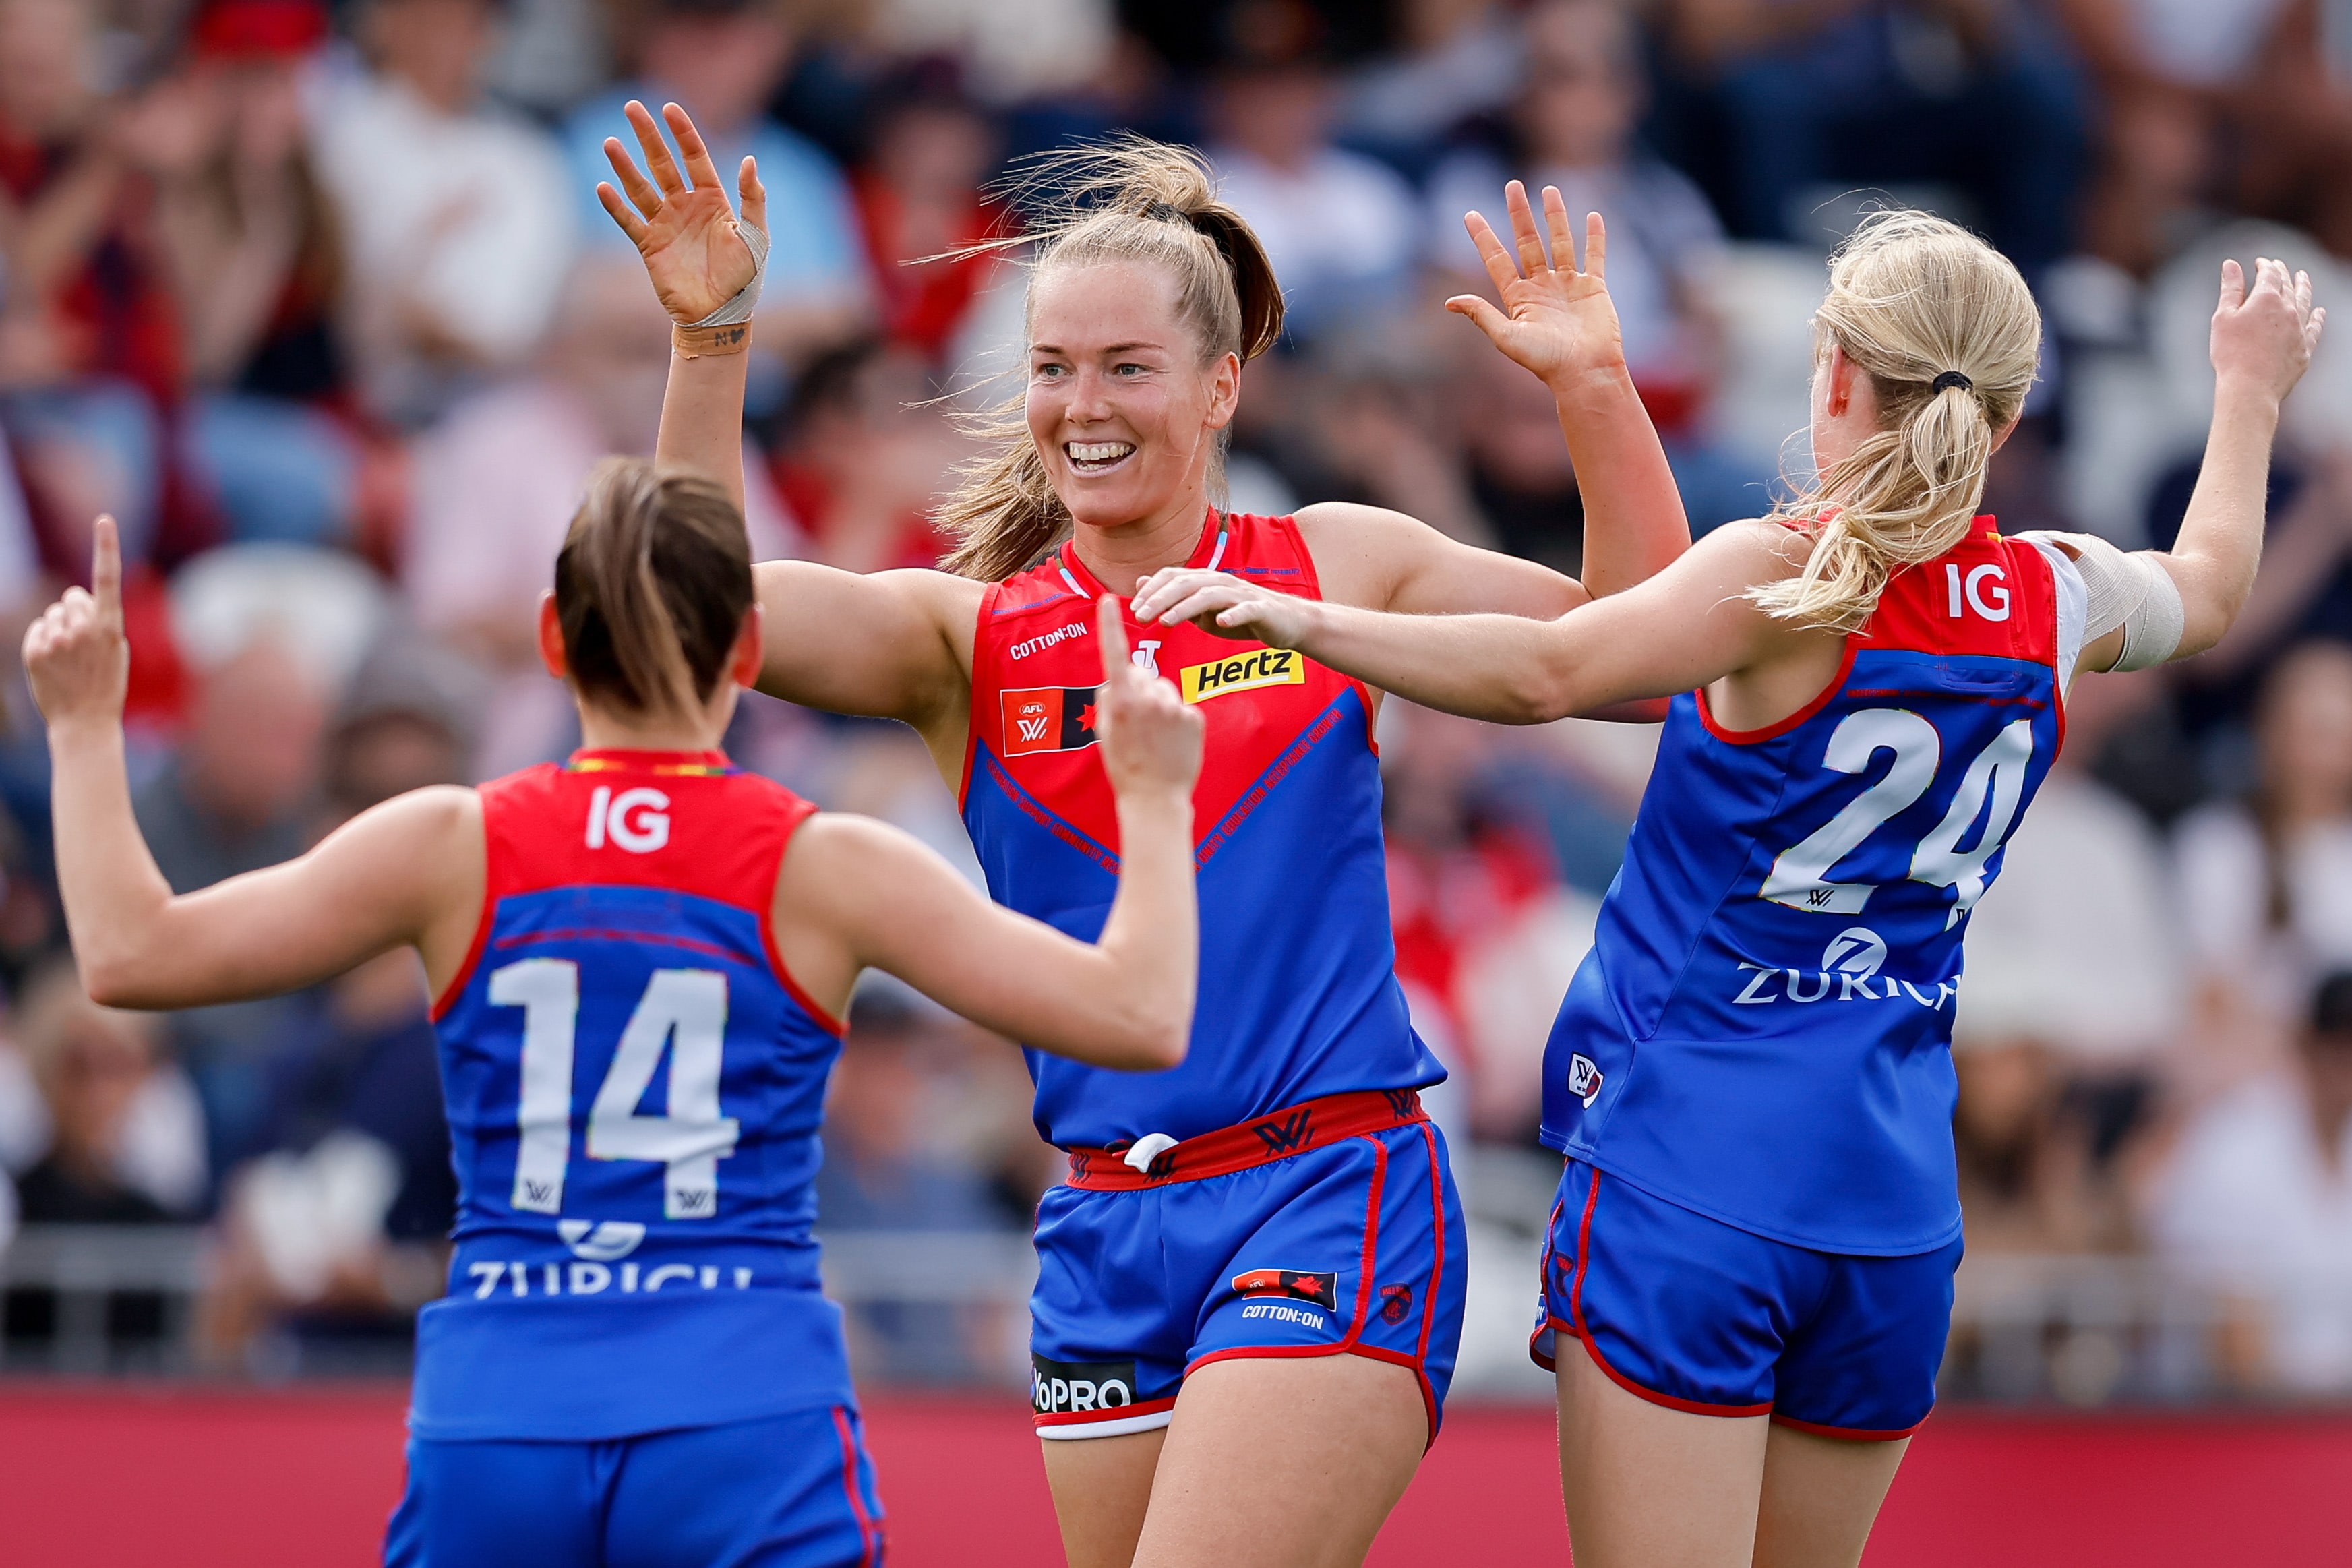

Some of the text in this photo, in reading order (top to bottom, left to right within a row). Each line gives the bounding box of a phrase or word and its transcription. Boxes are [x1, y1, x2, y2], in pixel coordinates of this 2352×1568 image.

[1946, 564, 2010, 622] IG
[1198, 651, 1292, 692] Hertz
[1022, 704, 1043, 714] AFL
[585, 785, 671, 853] IG
[1758, 708, 2034, 932] 24
[487, 957, 740, 1219] 14
